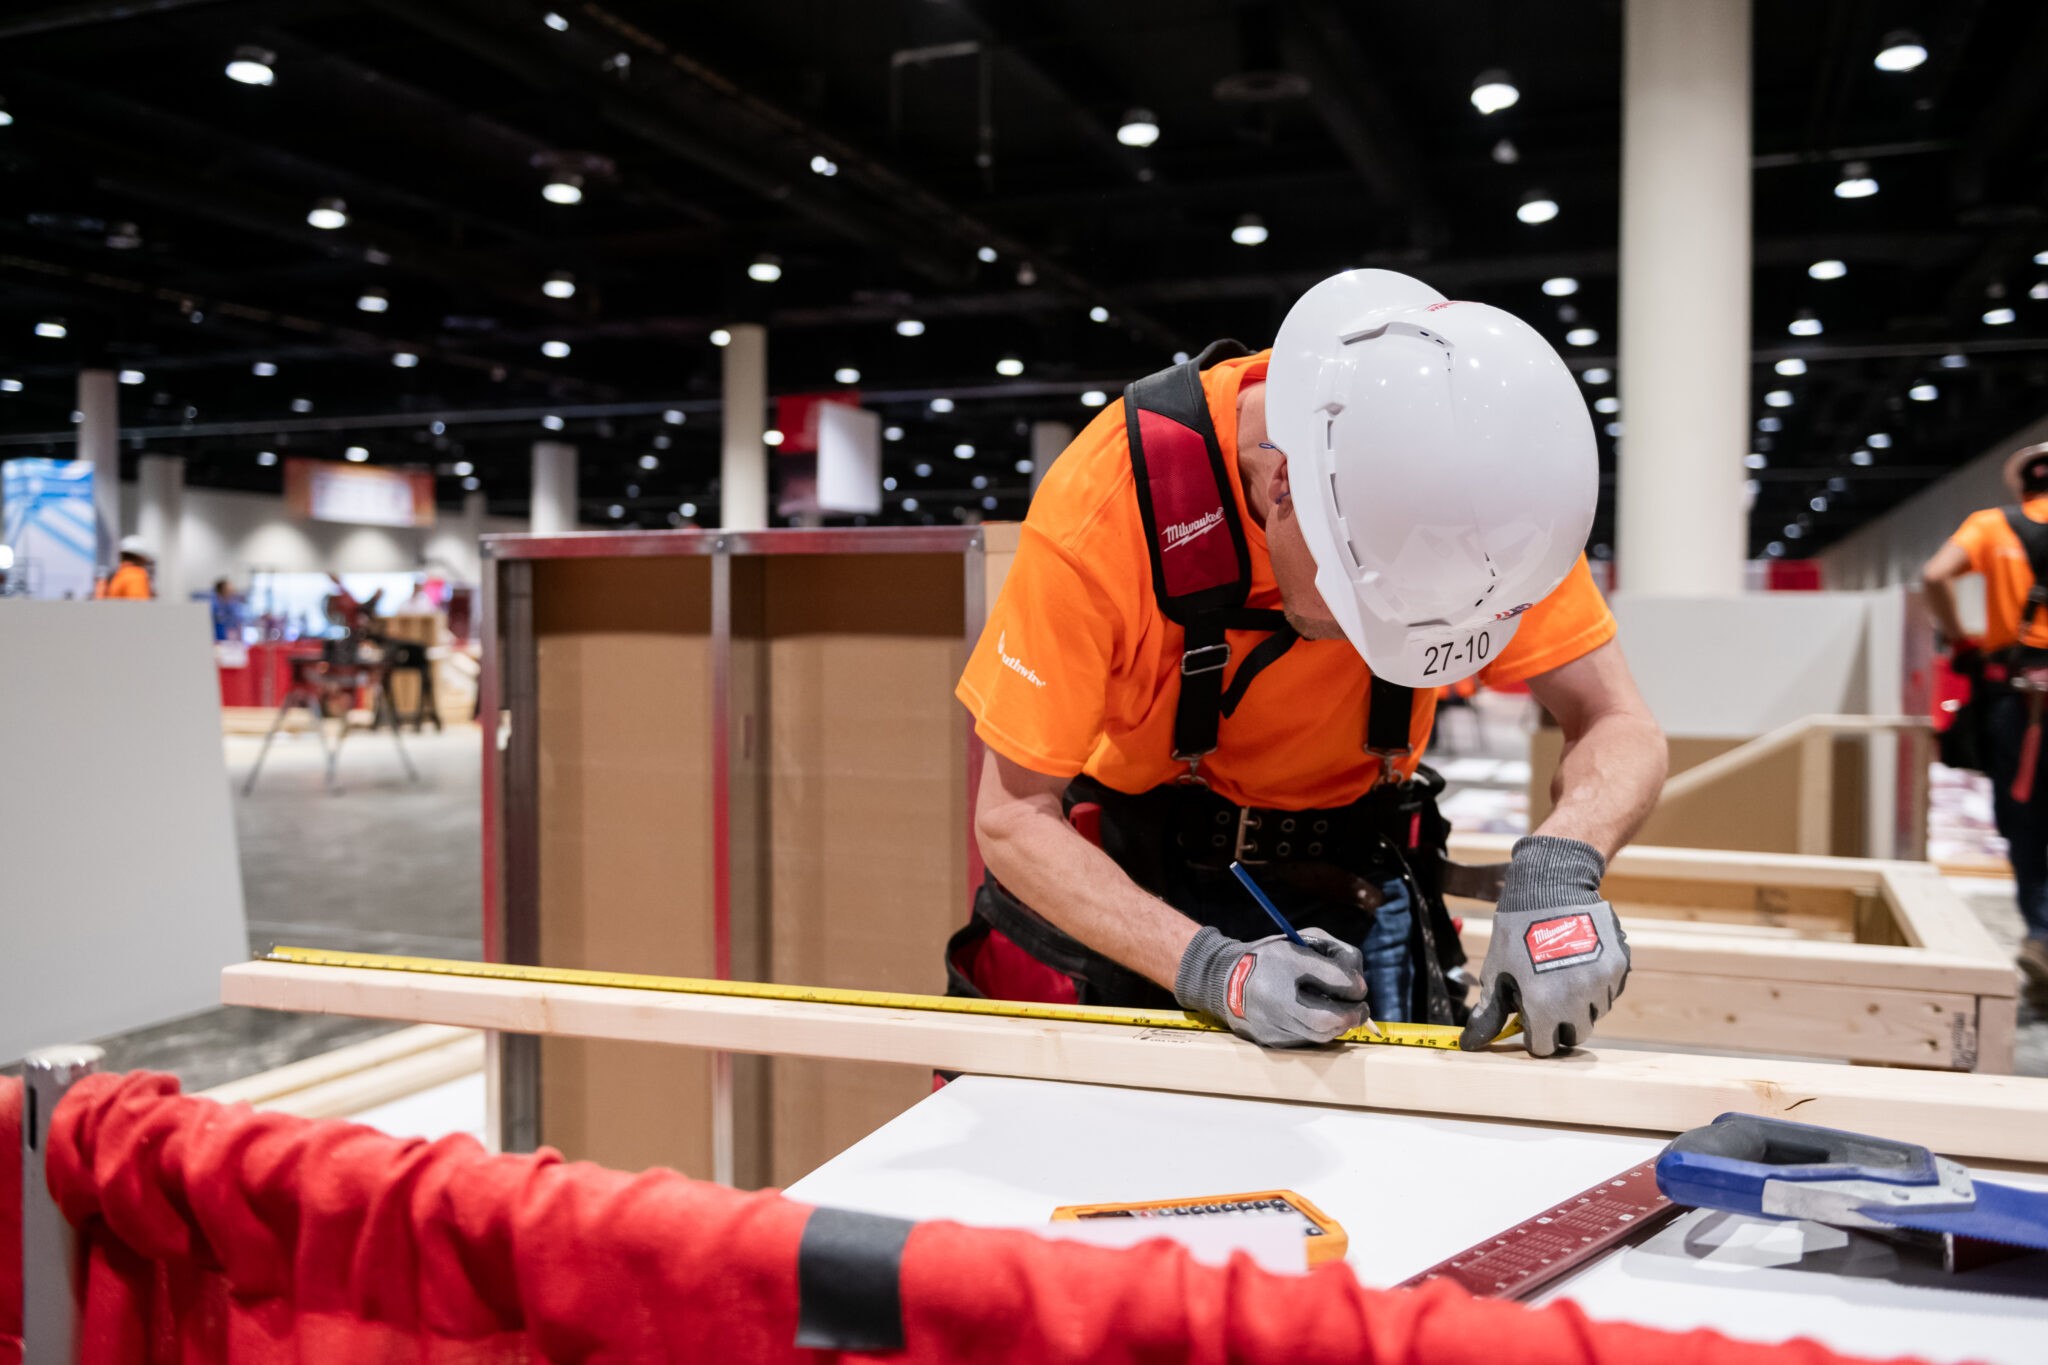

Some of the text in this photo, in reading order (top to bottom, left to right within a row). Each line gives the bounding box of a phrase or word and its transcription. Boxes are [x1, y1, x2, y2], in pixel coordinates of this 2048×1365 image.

[1161, 507, 1223, 543] Milwaukee
[1423, 631, 1489, 676] 27-10
[1533, 919, 1577, 944] Milwaukee
